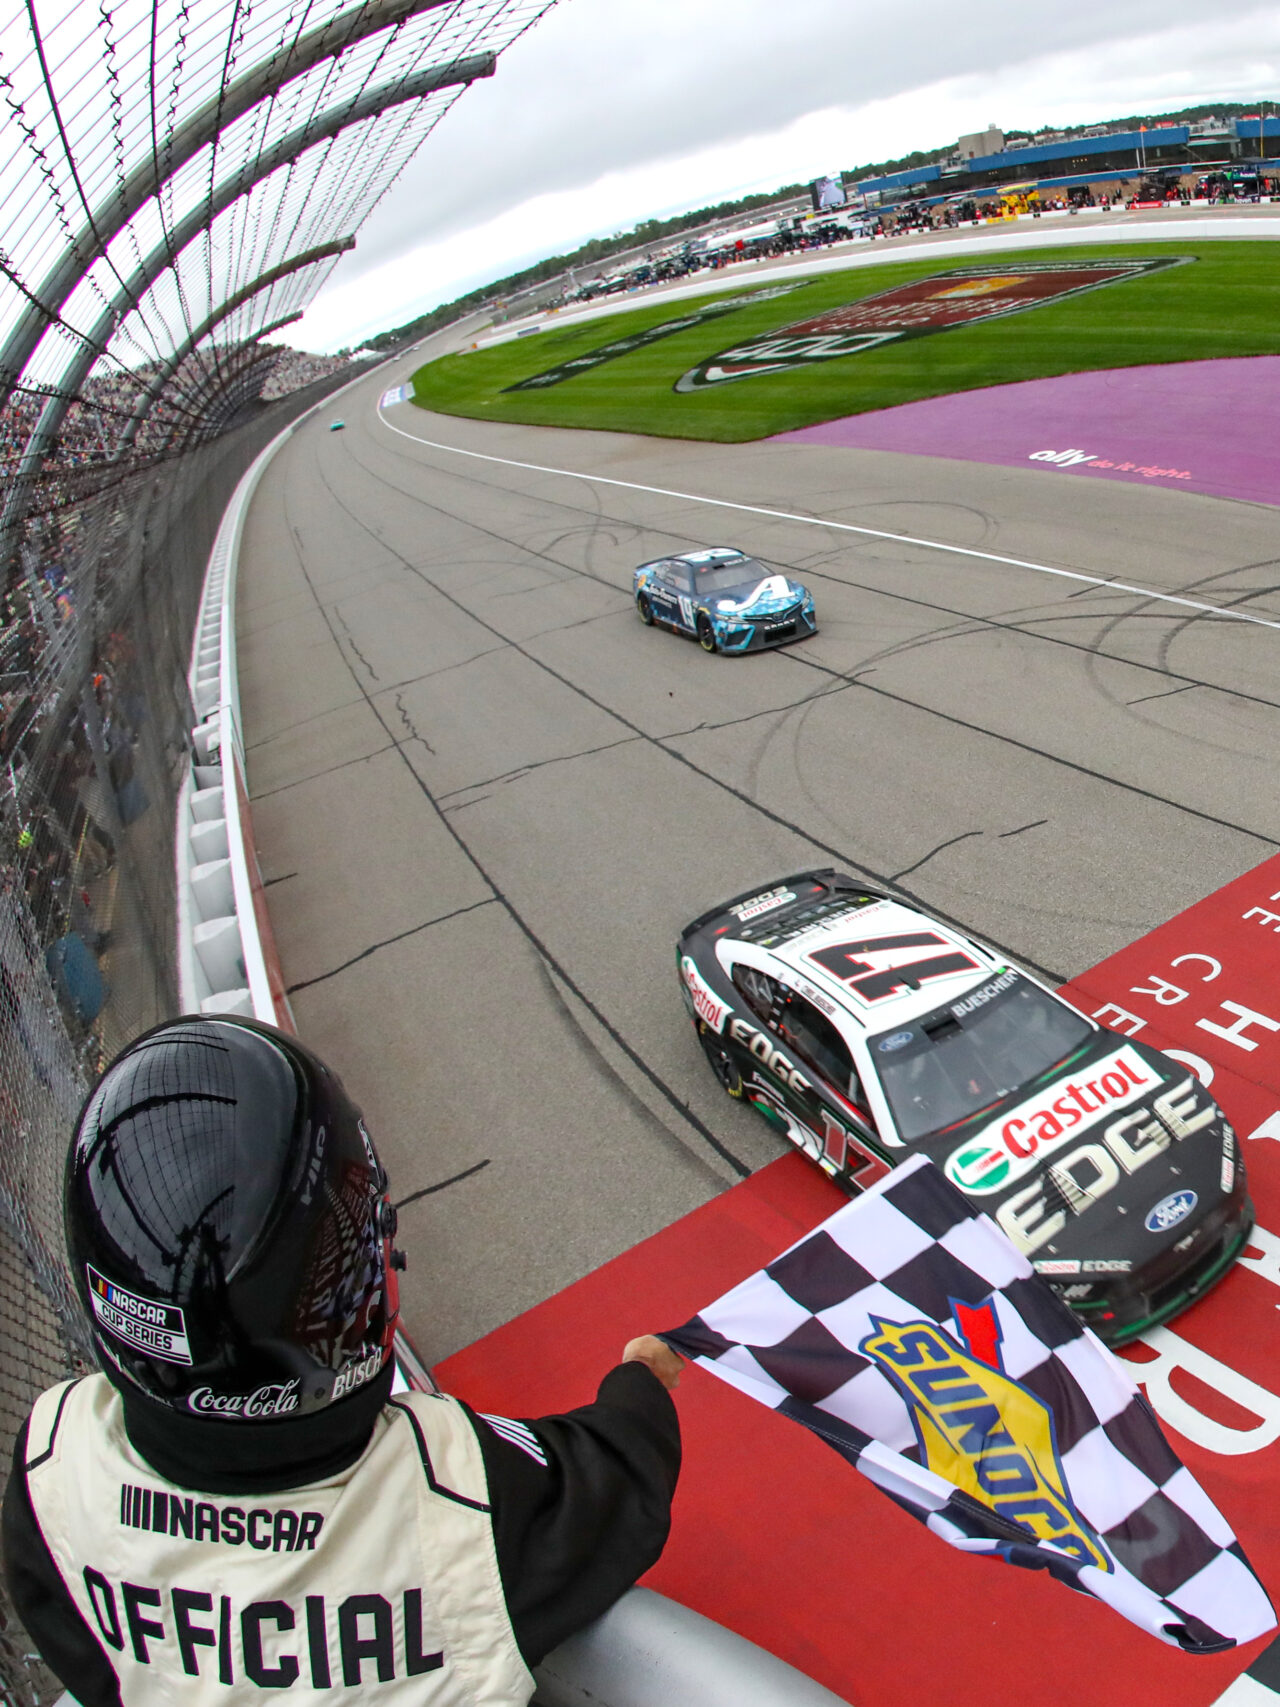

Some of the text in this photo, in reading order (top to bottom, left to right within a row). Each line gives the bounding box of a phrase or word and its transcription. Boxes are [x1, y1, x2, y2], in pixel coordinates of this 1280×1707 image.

[717, 331, 906, 362] 400
[1028, 448, 1192, 480] ally do it right.
[677, 594, 697, 630] 19
[728, 886, 789, 916] EDGE
[808, 931, 981, 1003] 17
[951, 972, 1020, 1019] BUESCHER
[1090, 953, 1222, 1037] CRE
[730, 1018, 814, 1094] EDGE
[1001, 1058, 1149, 1159] Castrol
[1222, 1122, 1234, 1160] EDGE
[996, 1073, 1217, 1258] EDGE
[1082, 1260, 1133, 1272] EDGE
[101, 1304, 173, 1350] CUP SERIES
[111, 1288, 167, 1327] NASCAR
[187, 1377, 302, 1418] Coca-Cola
[169, 1495, 325, 1552] NASCAR
[83, 1564, 444, 1690] OFFICIAL
